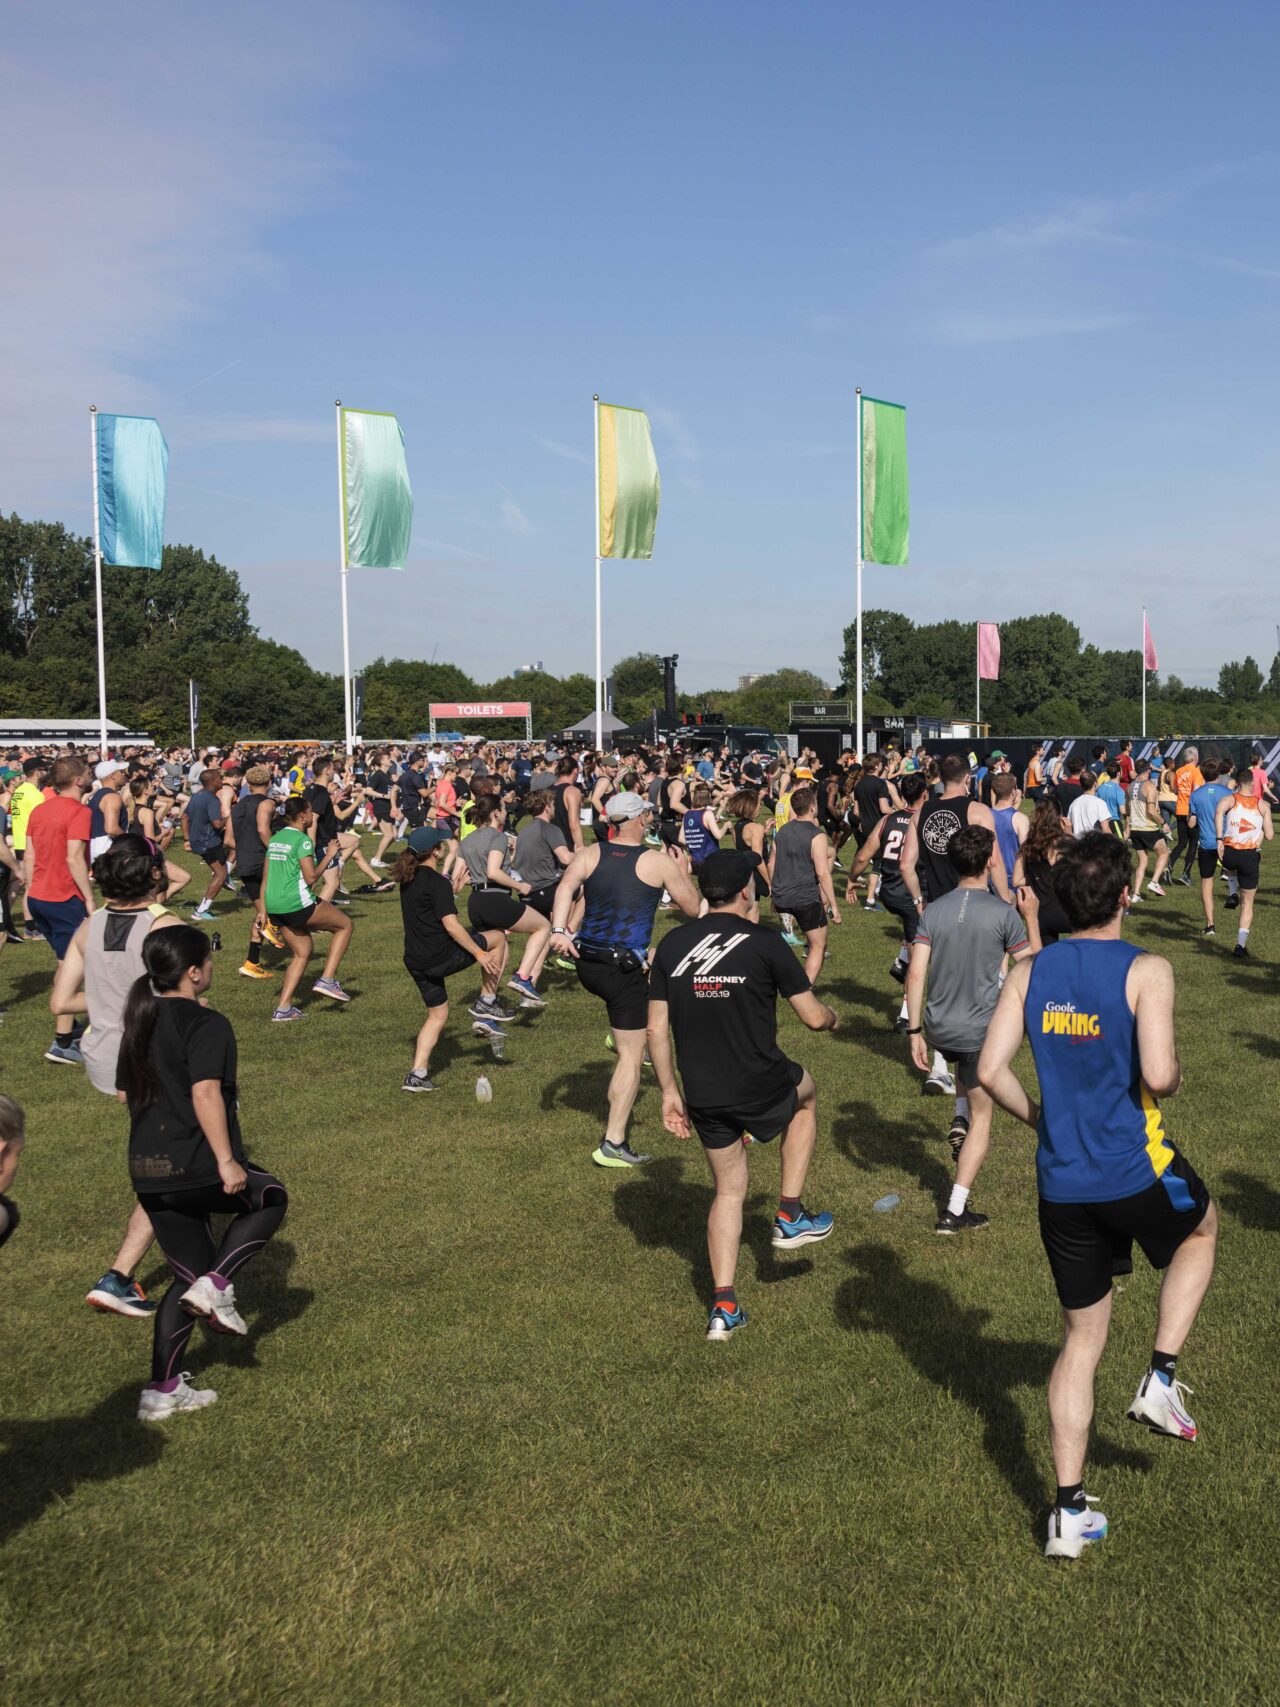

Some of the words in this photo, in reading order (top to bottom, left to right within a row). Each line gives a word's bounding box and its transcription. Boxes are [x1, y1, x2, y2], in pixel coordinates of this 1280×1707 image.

[457, 705, 504, 716] TOILETS
[814, 706, 826, 715] BAR
[884, 717, 904, 729] BAR
[883, 830, 907, 860] 2
[693, 975, 747, 984] HACKNEY
[693, 983, 722, 991] HALF
[694, 990, 730, 998] 19.05.19
[1045, 1001, 1076, 1013] Goole
[1042, 1010, 1100, 1037] VIKING
